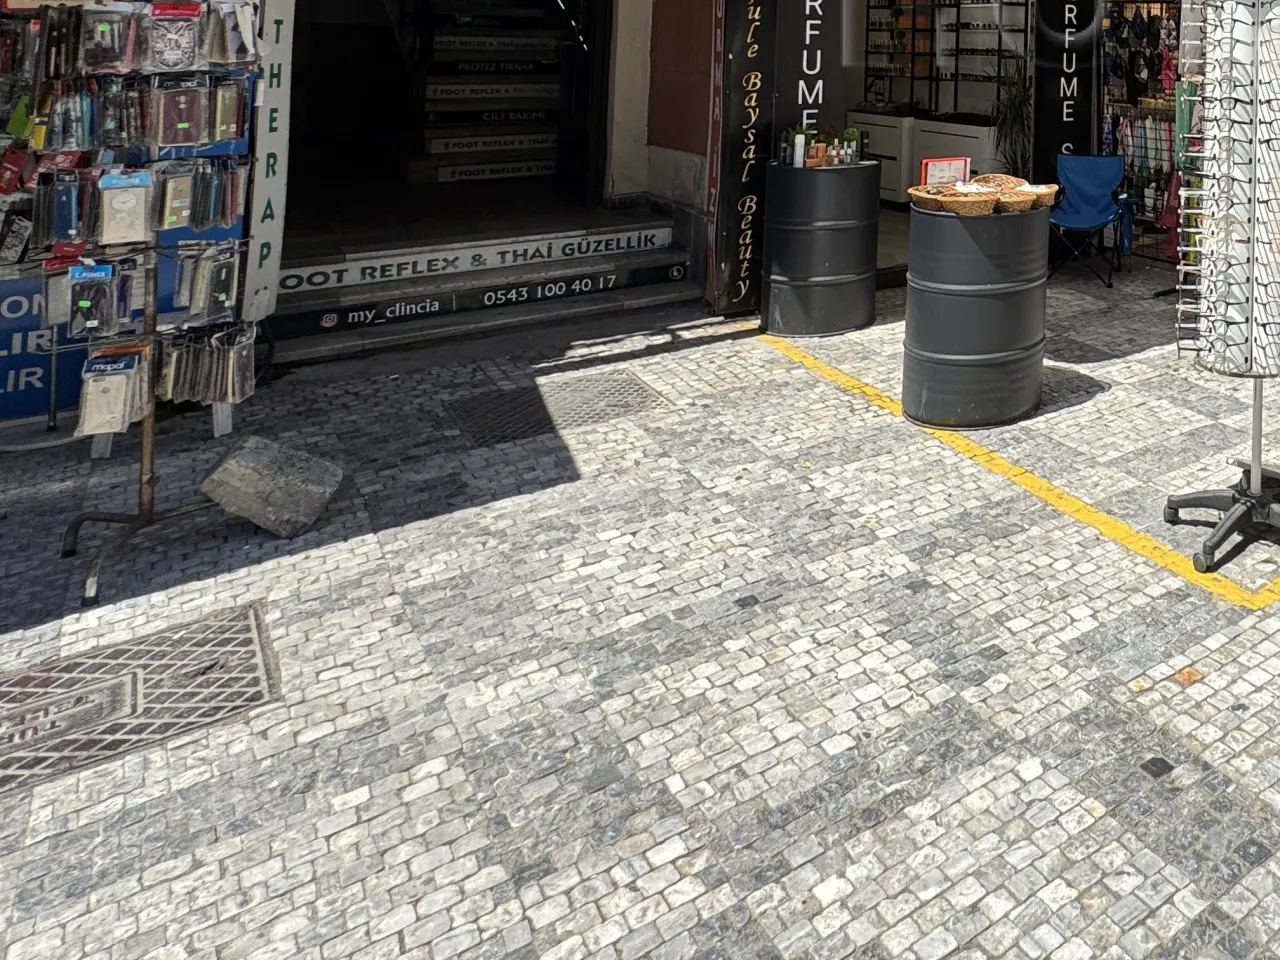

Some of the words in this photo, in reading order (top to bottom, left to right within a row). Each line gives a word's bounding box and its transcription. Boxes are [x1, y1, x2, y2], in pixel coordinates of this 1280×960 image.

[458, 62, 497, 71] PROTEZ
[500, 62, 535, 71] TIRNAK
[452, 141, 479, 149] FOOT
[741, 71, 763, 183] Baysal
[280, 268, 349, 290] OOT
[360, 255, 459, 281] REFLEX
[470, 253, 488, 268] &
[496, 244, 553, 265] THAİ
[560, 230, 657, 258] GÜZELLİK
[732, 195, 758, 303] Beauty
[348, 299, 440, 326] my_clincia
[483, 286, 529, 306] 0543
[536, 281, 567, 299] 100
[571, 278, 593, 292] 40
[599, 274, 617, 290] 17
